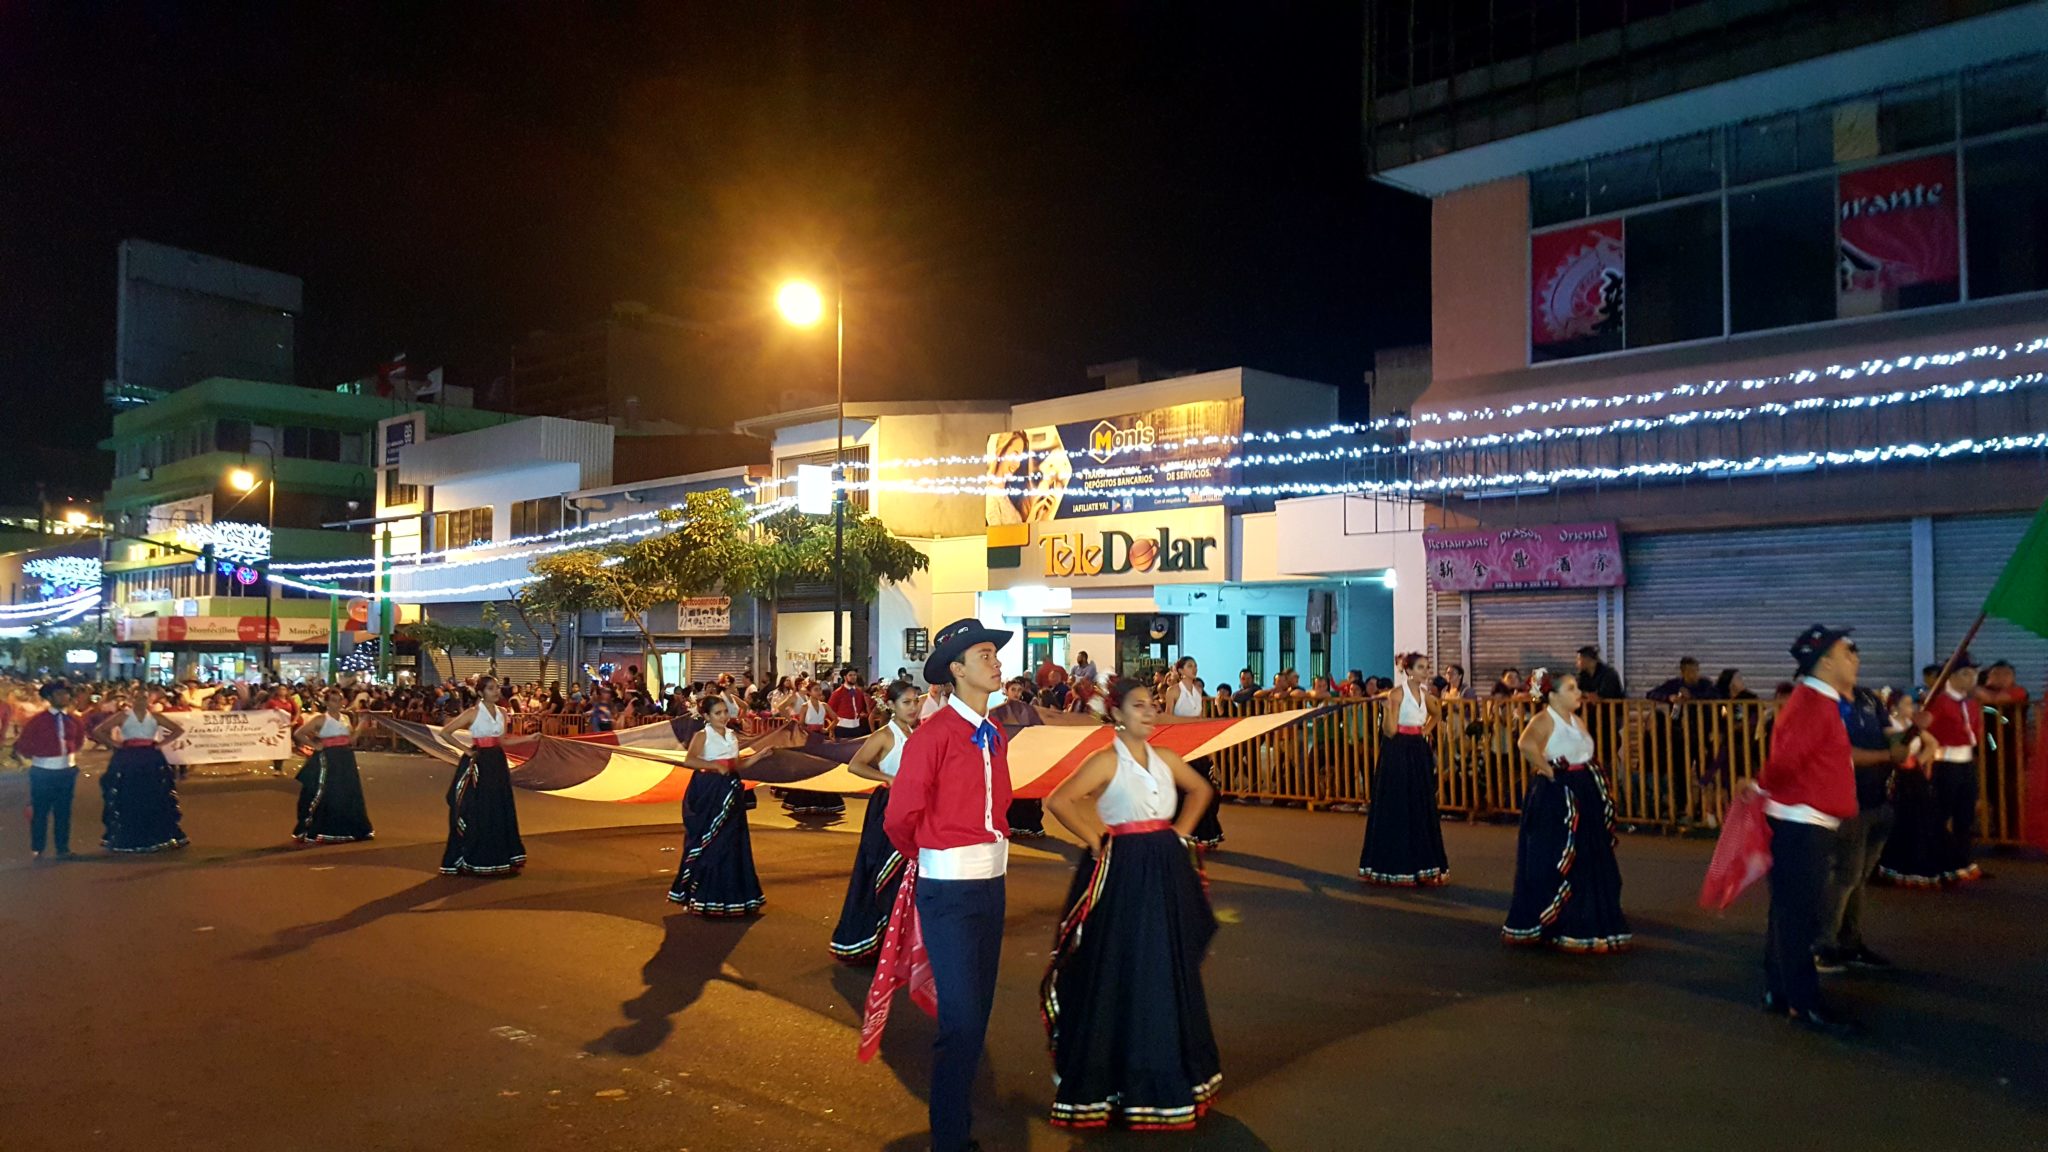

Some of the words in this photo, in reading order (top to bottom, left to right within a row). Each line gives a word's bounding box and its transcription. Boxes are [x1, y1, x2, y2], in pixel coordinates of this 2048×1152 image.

[1094, 420, 1155, 456] Monis
[1166, 472, 1175, 481] DE
[1559, 526, 1608, 543] Oriental
[289, 627, 329, 635] Montecill
